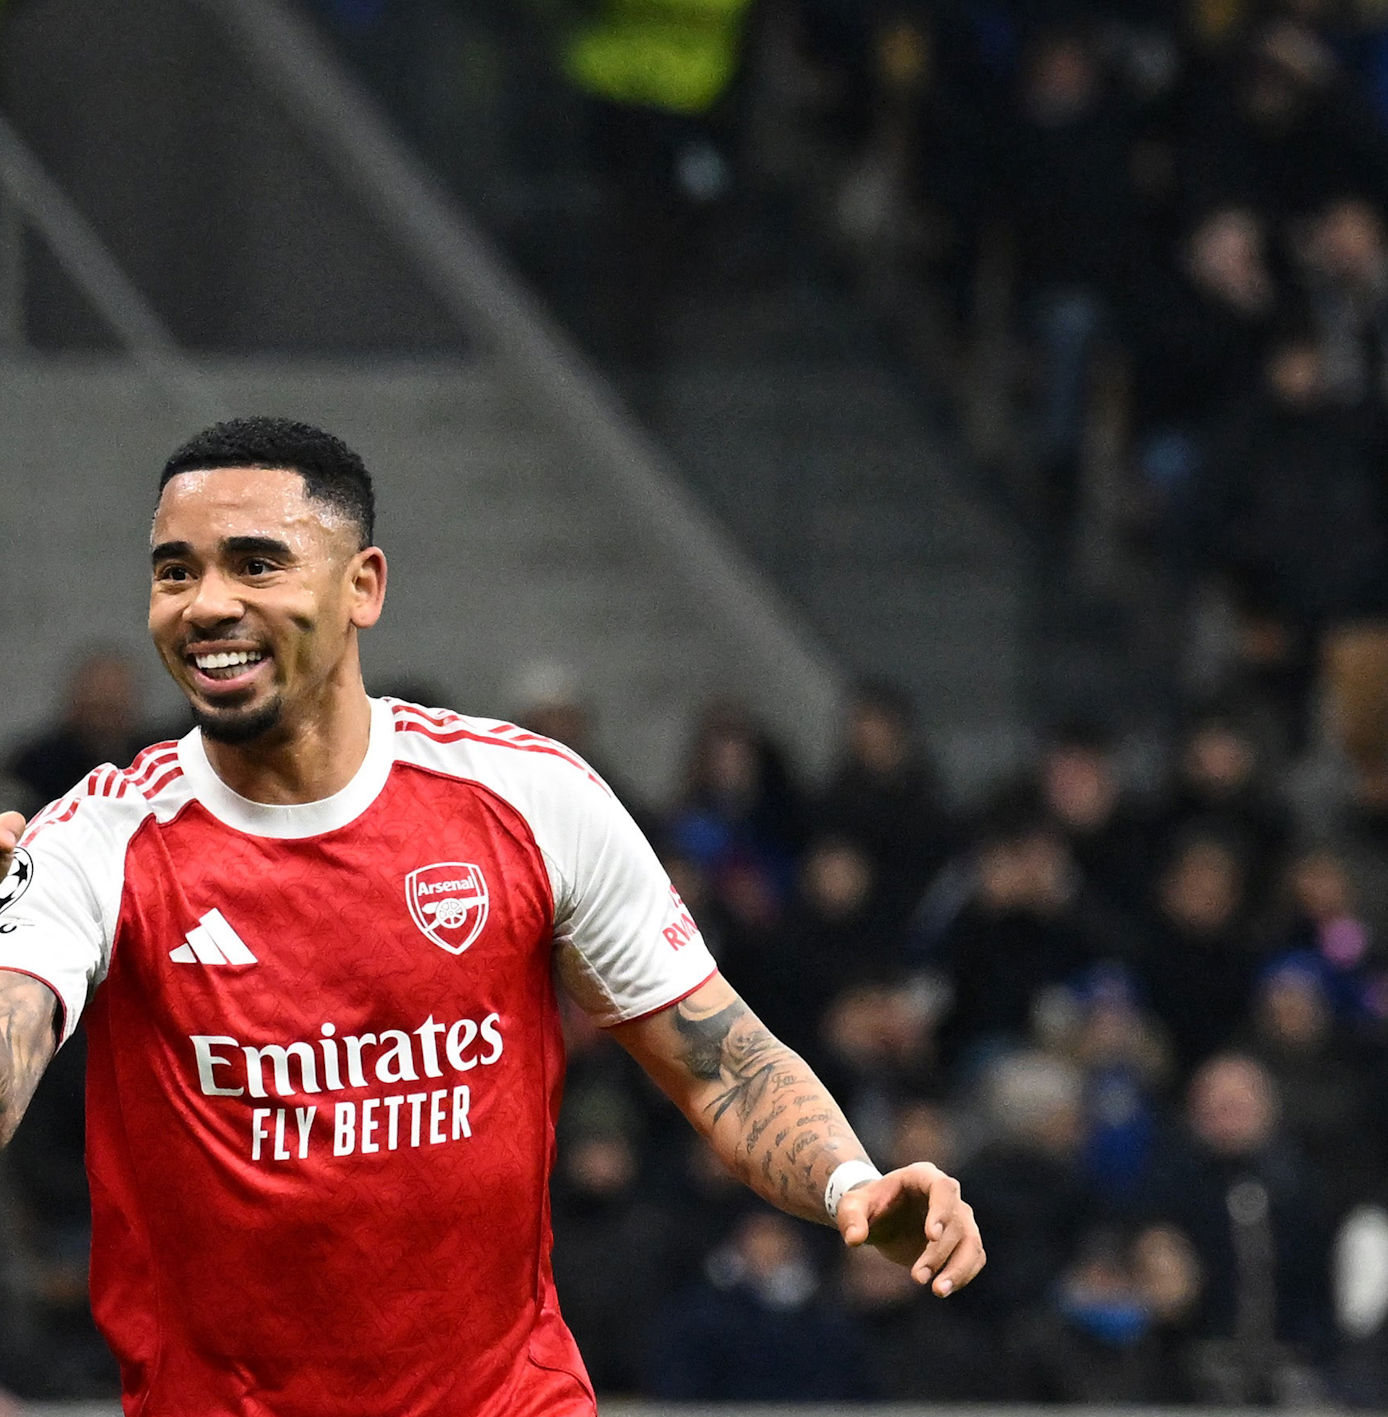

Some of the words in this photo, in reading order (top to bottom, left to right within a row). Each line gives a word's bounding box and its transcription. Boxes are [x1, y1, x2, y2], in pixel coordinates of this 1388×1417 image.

[418, 875, 476, 896] Arsenal
[189, 1012, 504, 1098] Emirates
[251, 1105, 317, 1161] FLY
[333, 1085, 472, 1157] BETTER
